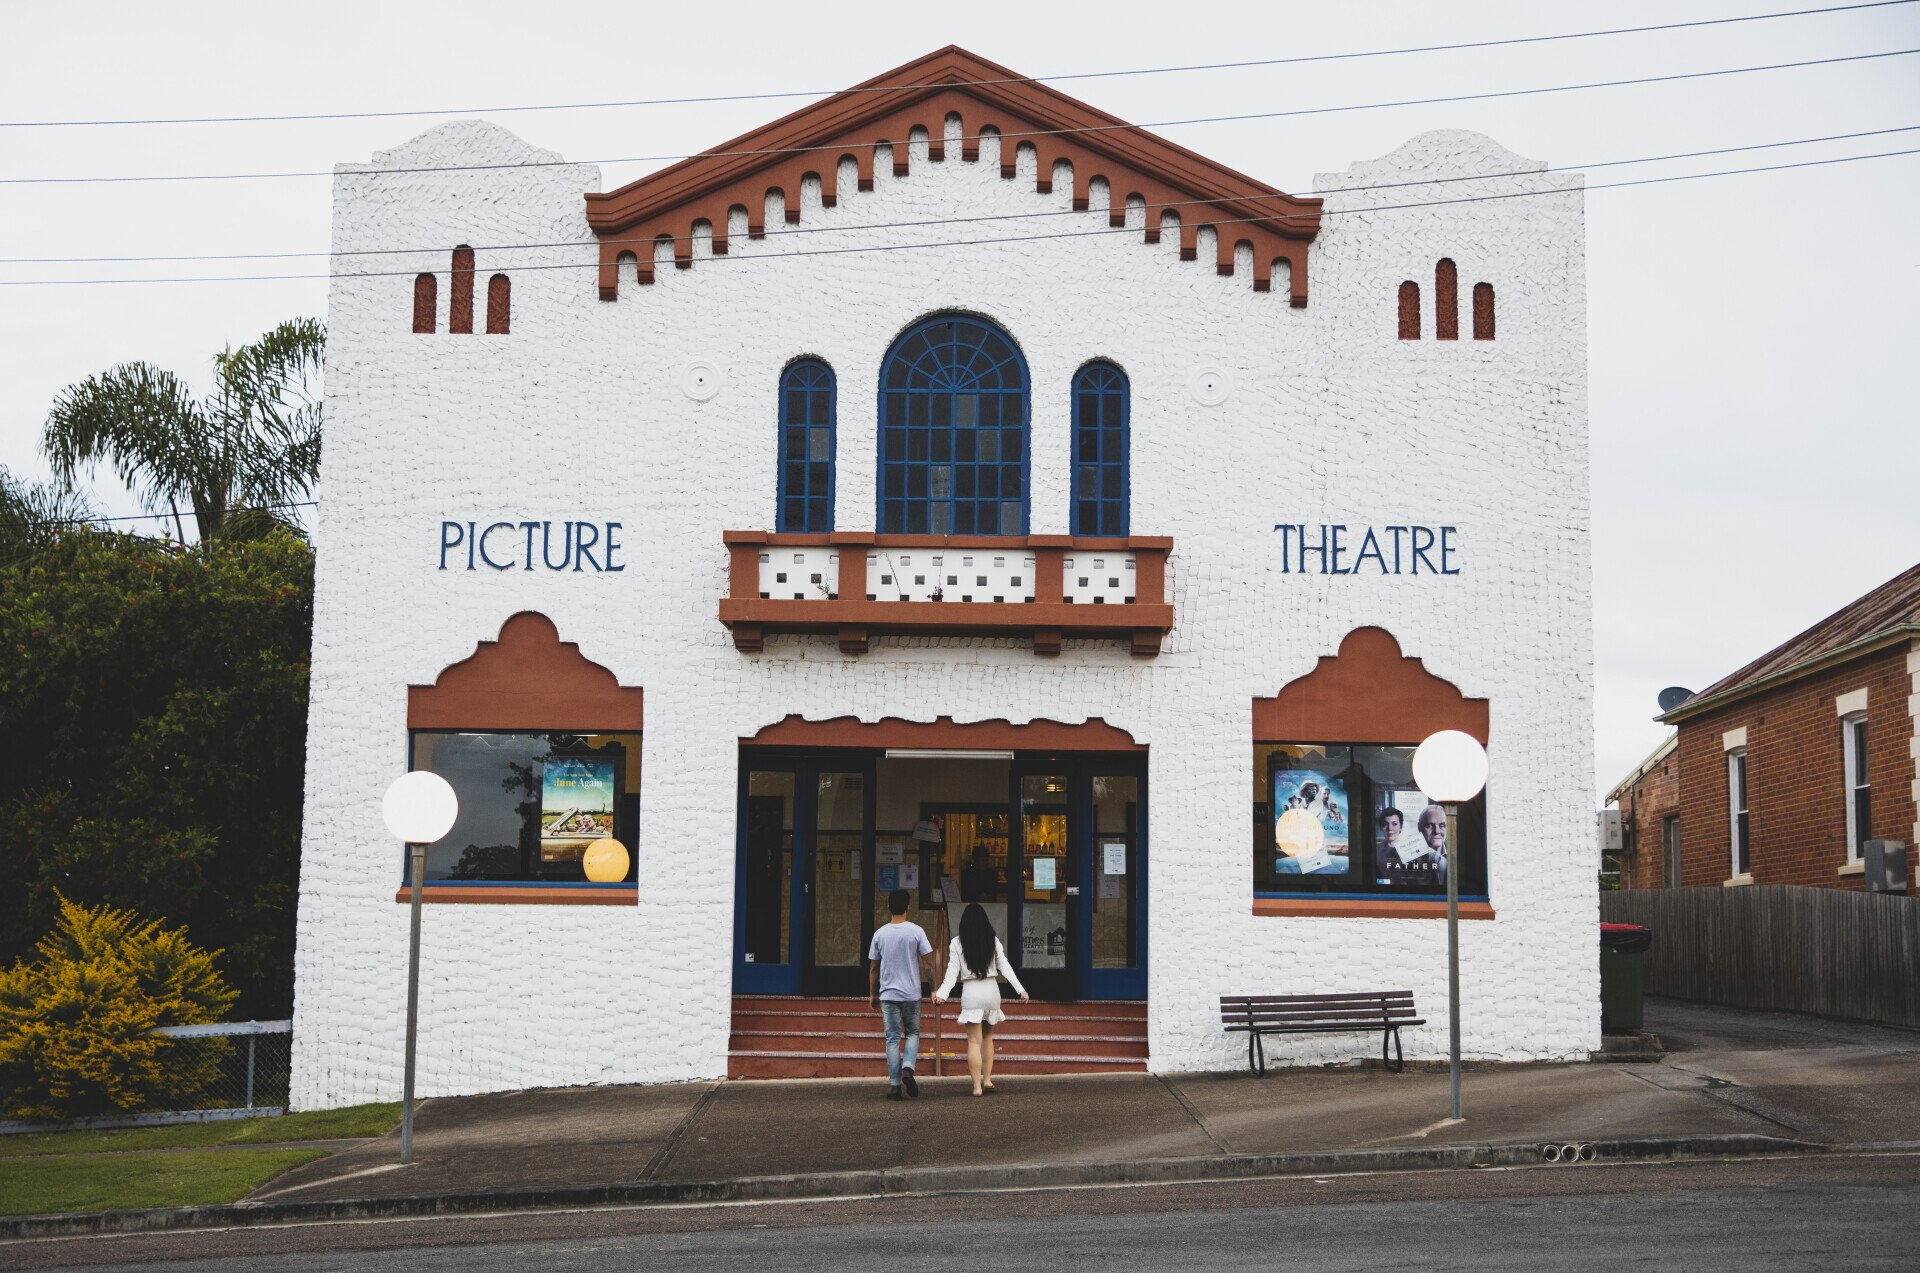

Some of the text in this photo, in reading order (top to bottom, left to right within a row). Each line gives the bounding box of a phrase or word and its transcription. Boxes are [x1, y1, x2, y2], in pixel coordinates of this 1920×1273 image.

[438, 521, 626, 572] PICTURE
[1273, 524, 1461, 575] THEATRE
[554, 778, 602, 789] June Again
[1386, 862, 1438, 870] FATHER
